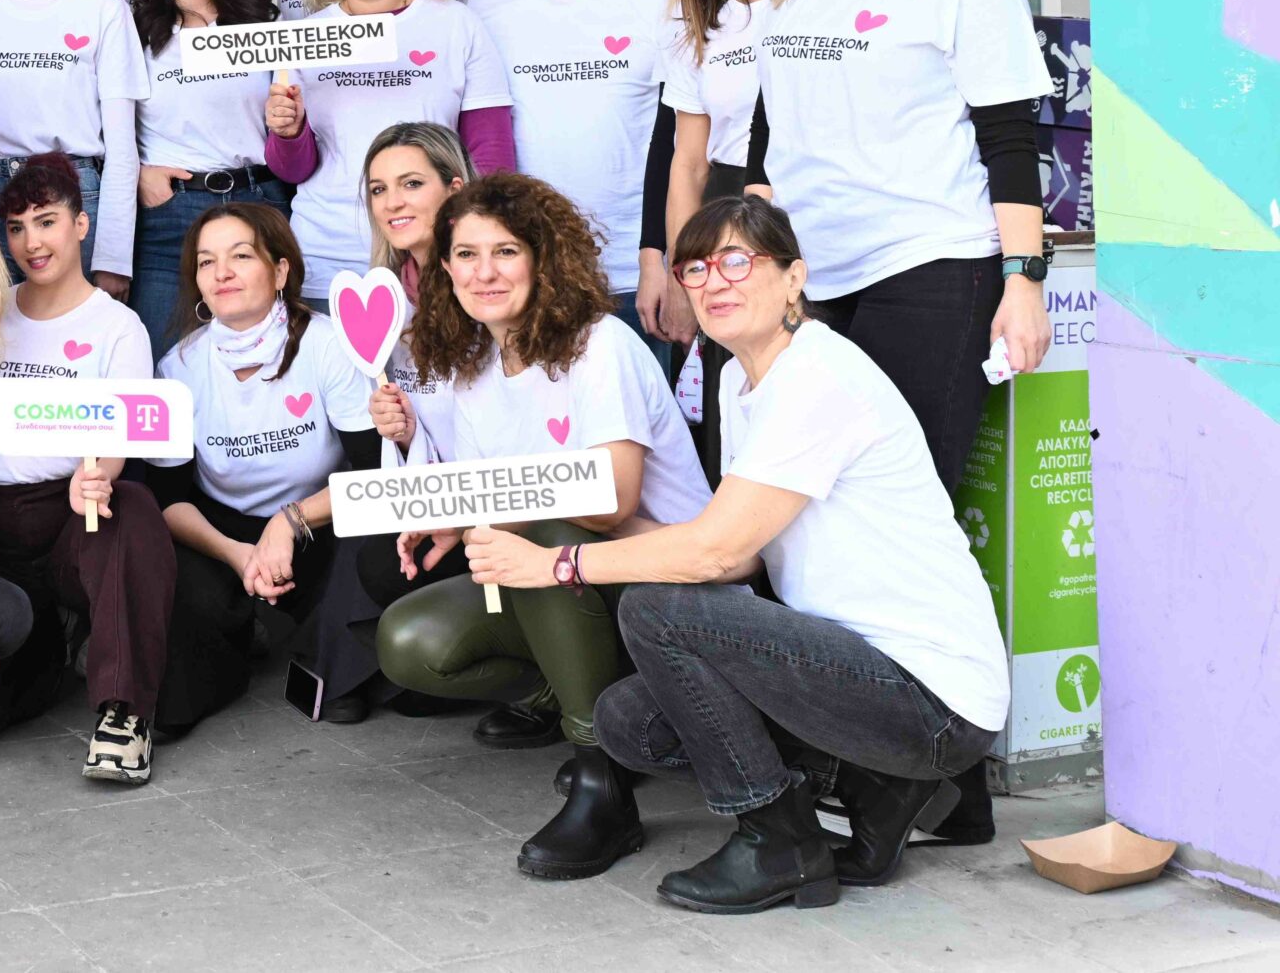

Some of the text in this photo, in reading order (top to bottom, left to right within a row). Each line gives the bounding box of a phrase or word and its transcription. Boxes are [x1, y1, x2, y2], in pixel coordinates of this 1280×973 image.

[192, 22, 384, 51] COSMOTE TELEKOM
[761, 35, 869, 52] COSMOTE TELEKOM
[226, 42, 352, 66] VOLUNTEERS
[709, 46, 753, 65] COSMO
[771, 47, 842, 61] VOLUNTEERS
[318, 70, 432, 81] COSMOTE TELEKOM
[513, 60, 629, 74] COSMOTE TELEKOM
[336, 78, 411, 87] VOLUNTEERS
[534, 70, 609, 82] VOLUNTEERS
[1046, 290, 1097, 313] UMAN
[1054, 321, 1095, 345] EEC
[24, 363, 78, 378] TELEKOM
[14, 404, 115, 420] COSMOTE
[206, 421, 316, 447] COSMOTE TELEKOM
[1060, 418, 1091, 433] ΚΑΔΟ
[226, 438, 299, 458] VOLUNTEERS
[1036, 436, 1091, 452] ΑΝΑΚΥΚ
[1039, 454, 1091, 470] ΑΠΟΤΣΙΓ
[345, 460, 597, 501] COSMOTE TELEKOM
[1030, 470, 1092, 488] CIGARETTE
[390, 488, 556, 521] VOLUNTEERS
[1047, 488, 1093, 505] RECYCL
[1040, 724, 1083, 740] CIGARET
